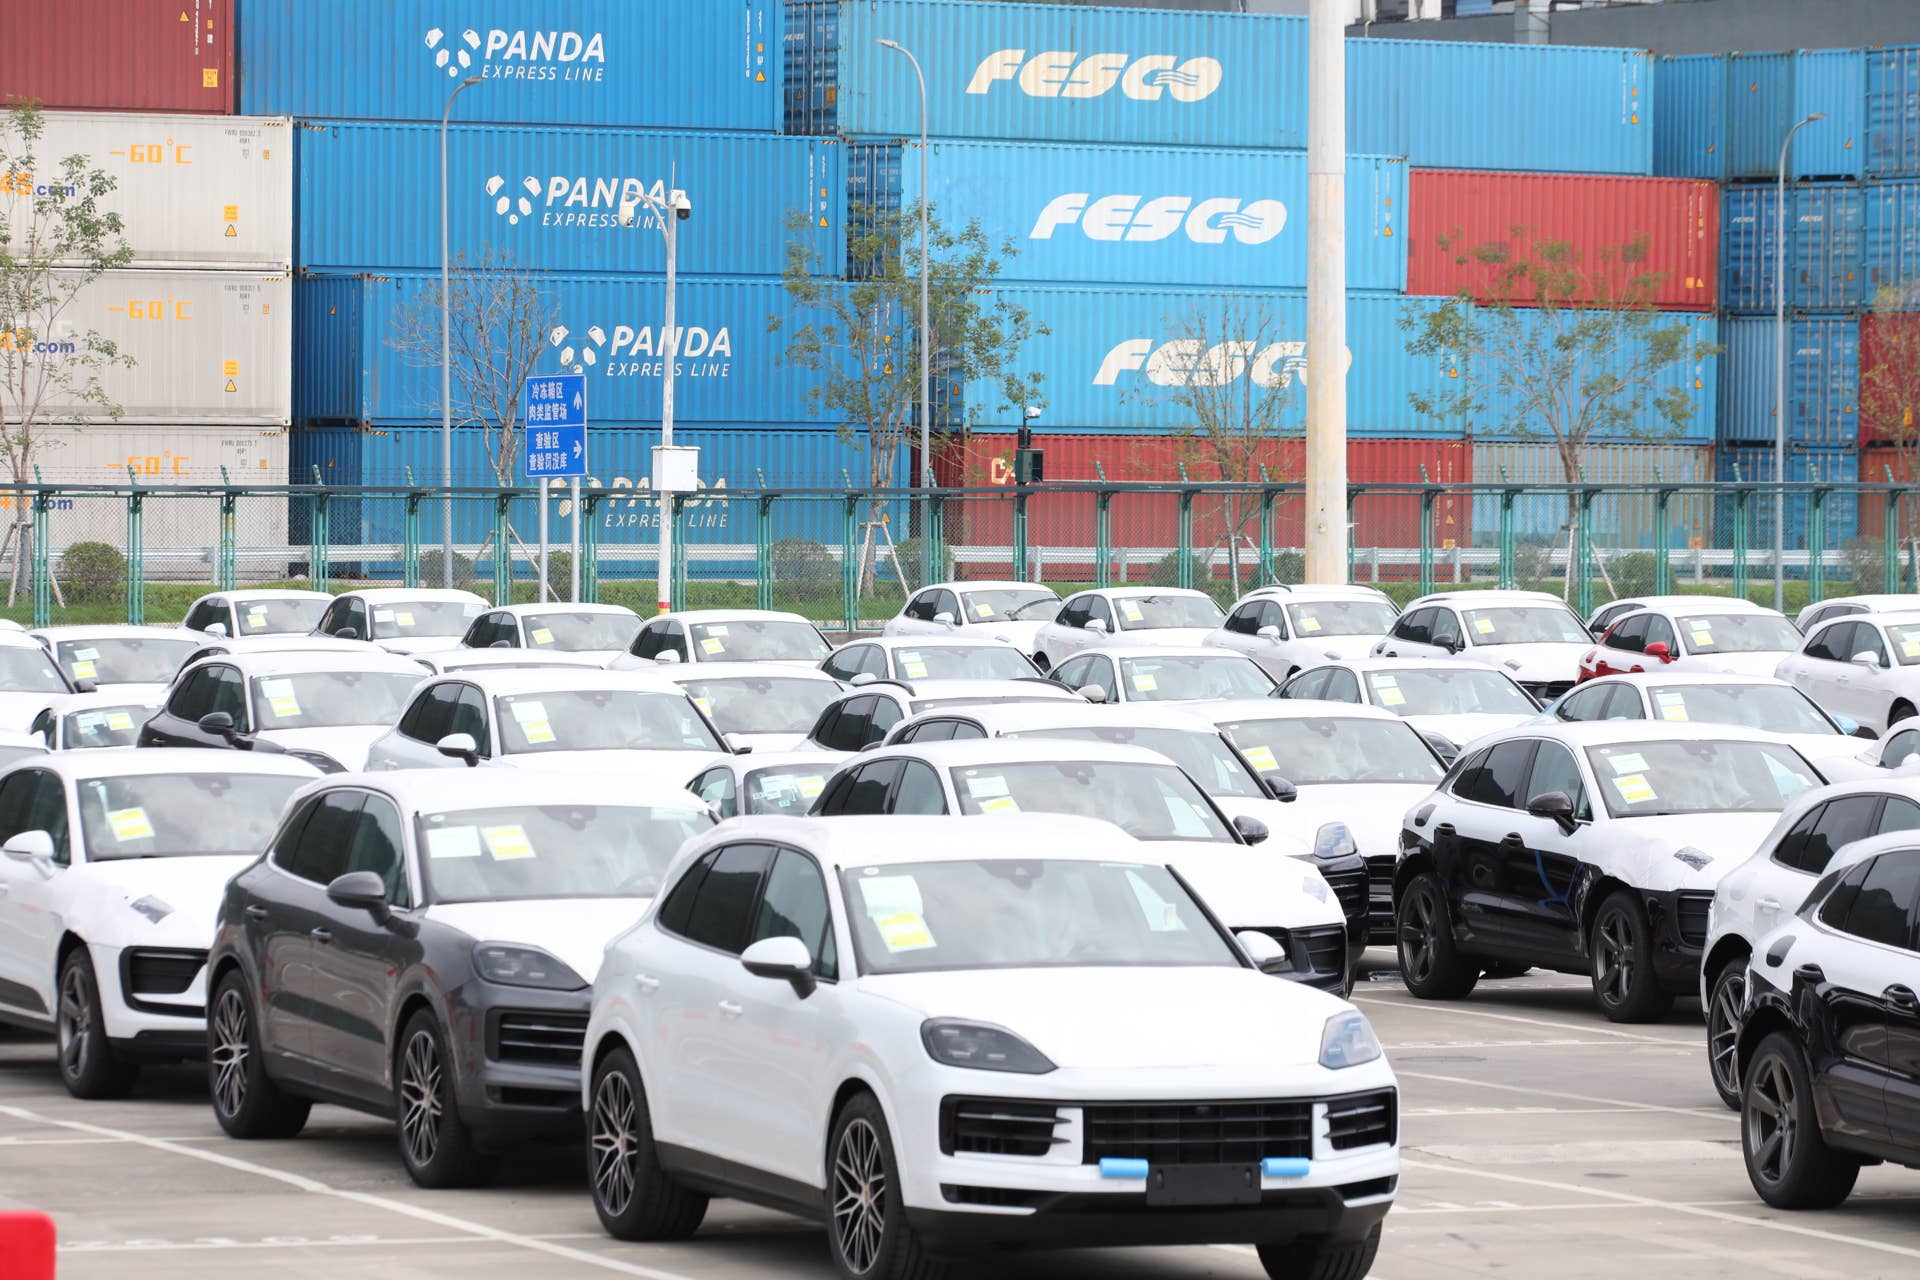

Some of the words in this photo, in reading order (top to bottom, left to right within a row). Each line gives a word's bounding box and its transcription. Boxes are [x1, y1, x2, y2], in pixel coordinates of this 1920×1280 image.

[485, 29, 605, 63] PANDA
[482, 64, 557, 80] EXPRESS
[565, 67, 604, 81] LINE
[965, 49, 1223, 102] FESCO
[546, 176, 667, 210] PANDA
[543, 212, 618, 228] EXPRESS
[627, 215, 666, 229] INE
[1029, 193, 1288, 245] FESCO
[611, 325, 732, 358] PANDA
[607, 362, 683, 377] EXPRES
[691, 363, 731, 377] LINE
[1092, 338, 1353, 388] FESC
[531, 381, 564, 400] 冷冻箱区
[535, 431, 560, 450] 查验区
[608, 476, 729, 508] PAA
[605, 513, 677, 528] EXPRE
[687, 514, 729, 528] LINE
